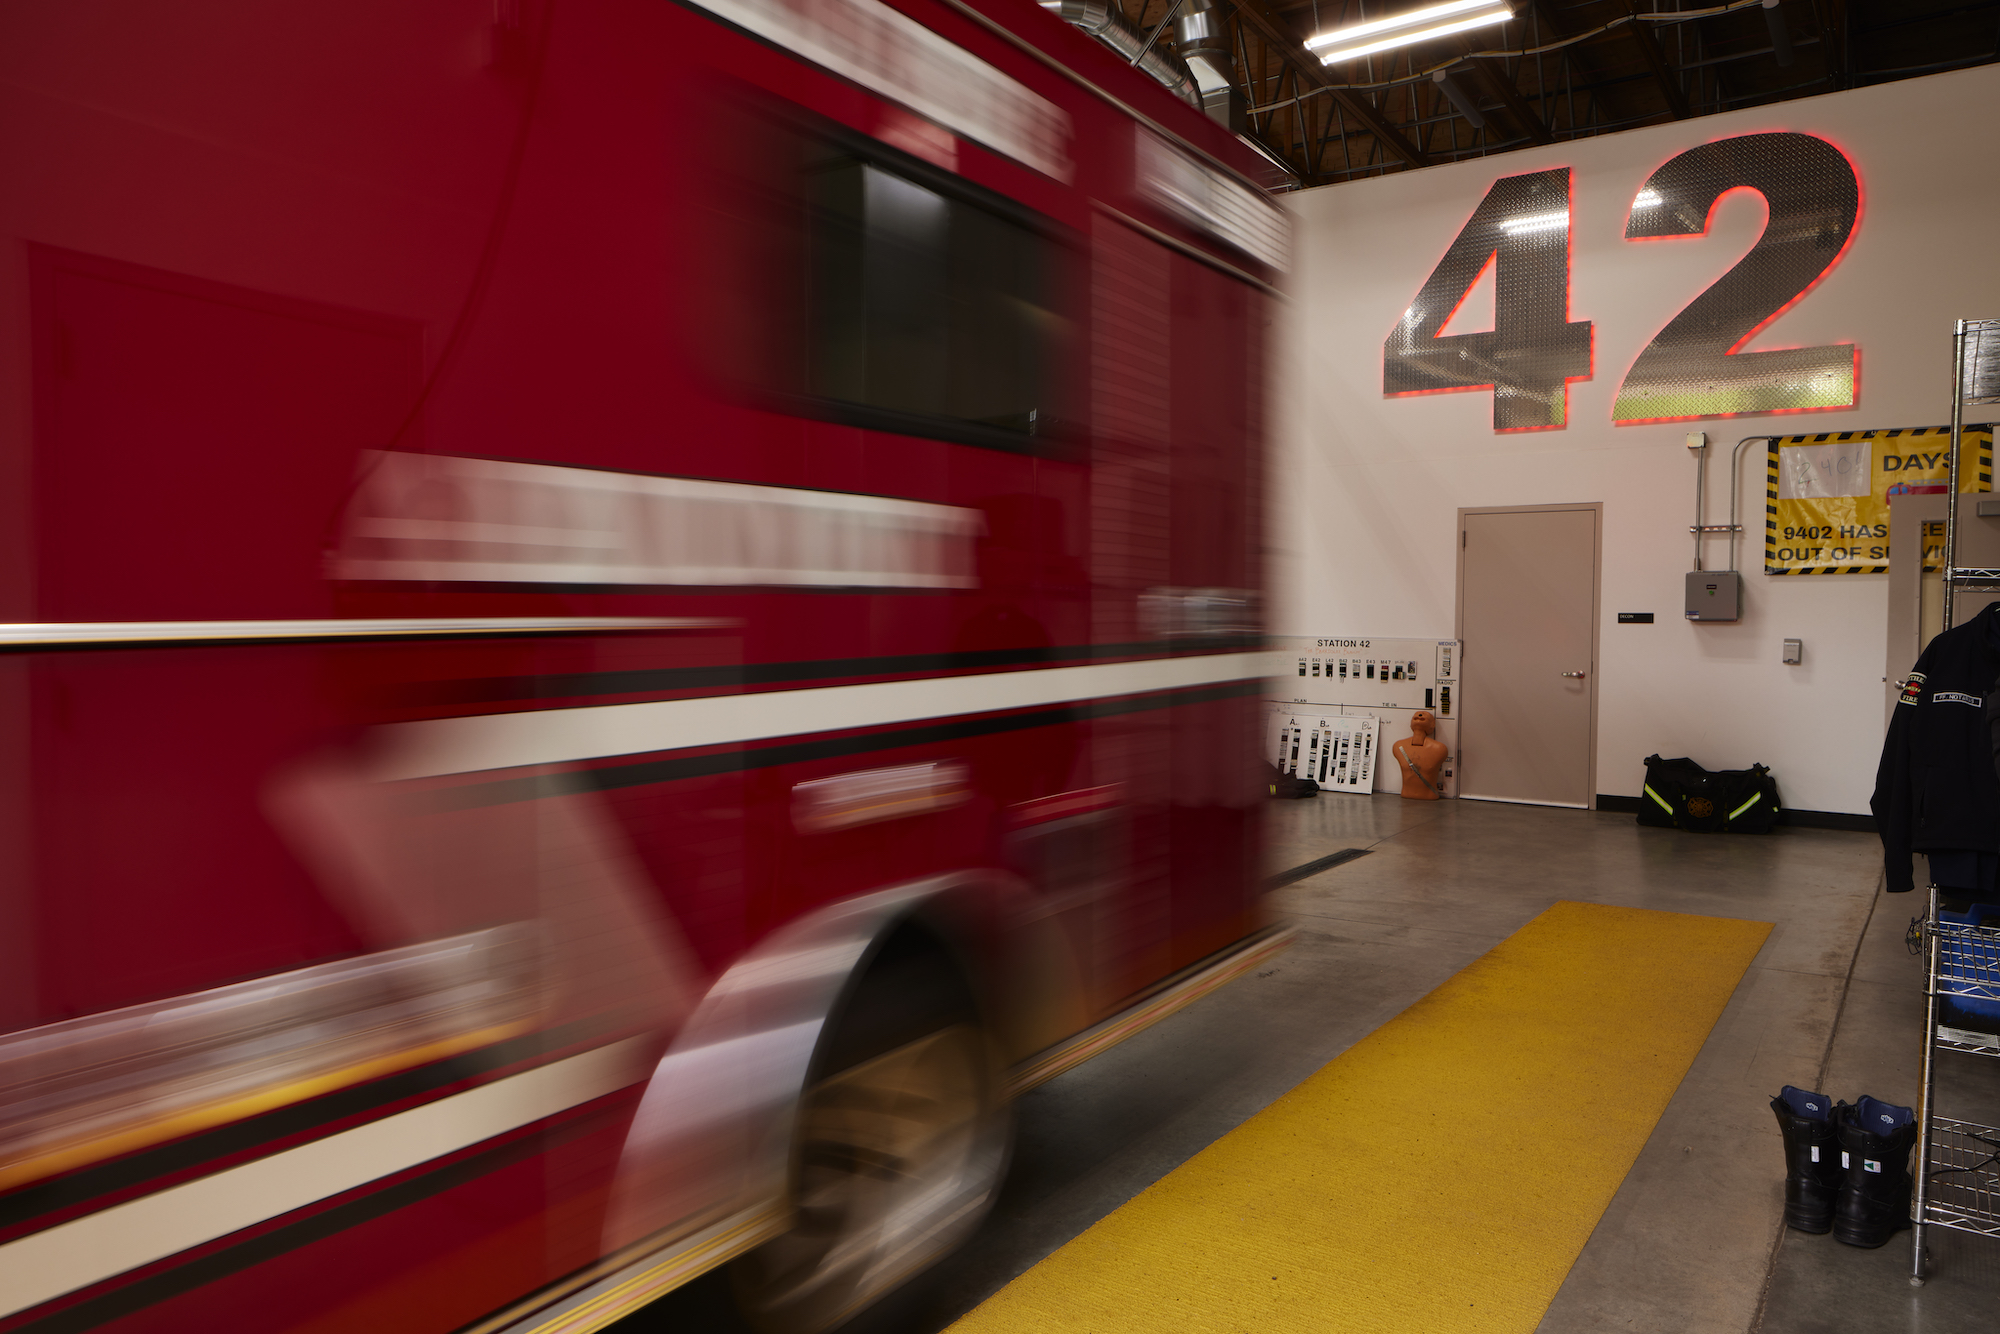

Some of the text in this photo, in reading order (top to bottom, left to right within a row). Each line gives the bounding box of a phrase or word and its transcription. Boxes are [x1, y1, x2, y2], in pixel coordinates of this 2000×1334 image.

[1383, 131, 1861, 430] 42
[1784, 524, 1887, 539] 9402 HAS
[1778, 548, 1824, 560] OUT
[1831, 547, 1862, 560] OF
[1317, 639, 1371, 648] STATION 42
[1902, 694, 1918, 703] FIRE
